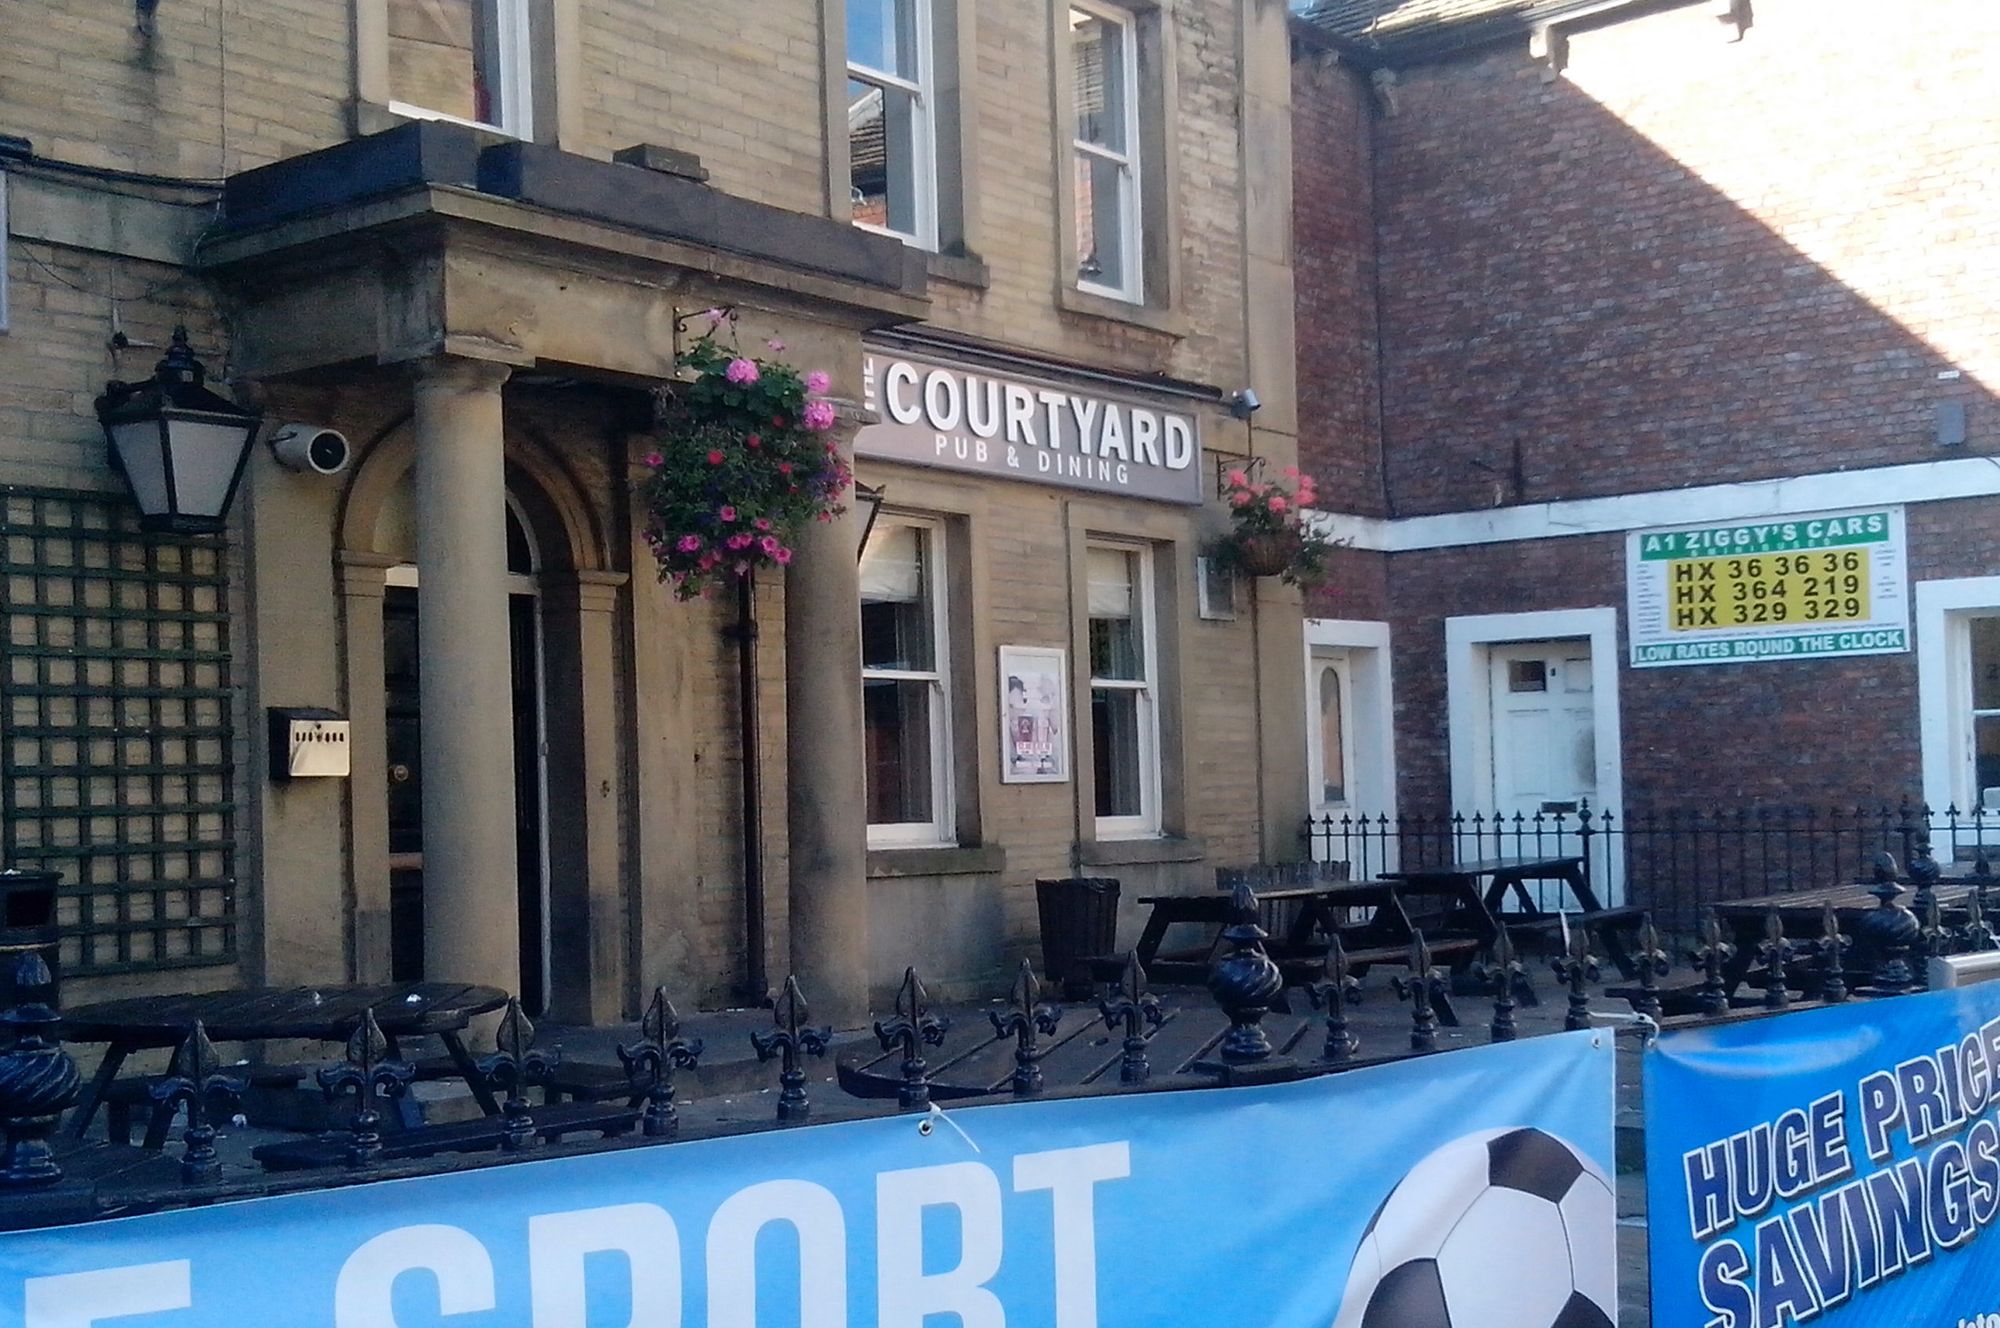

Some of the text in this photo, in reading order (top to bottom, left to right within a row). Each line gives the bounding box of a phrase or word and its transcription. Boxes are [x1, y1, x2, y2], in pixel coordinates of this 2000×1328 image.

[886, 362, 1192, 470] COURTYARD
[935, 433, 1128, 484] PUB & DINING
[1645, 515, 1882, 551] A1 ZIGGY'S CARS
[1676, 562, 1715, 583] HX
[1728, 558, 1762, 579] 36
[1775, 555, 1810, 576] 36
[1823, 552, 1859, 573] 36
[1677, 584, 1716, 605] HX
[1732, 580, 1787, 601] 364
[1804, 575, 1859, 596] 219
[1678, 598, 1860, 627] HX 329 329
[1638, 646, 1673, 661] LOW
[1676, 642, 1730, 659] RATES
[1734, 637, 1795, 656] ROUND
[1799, 634, 1835, 652] THE
[1840, 631, 1900, 649] CLOCK
[1683, 1090, 1851, 1240] HUGE
[1698, 1119, 2000, 1328] SAVINGS
